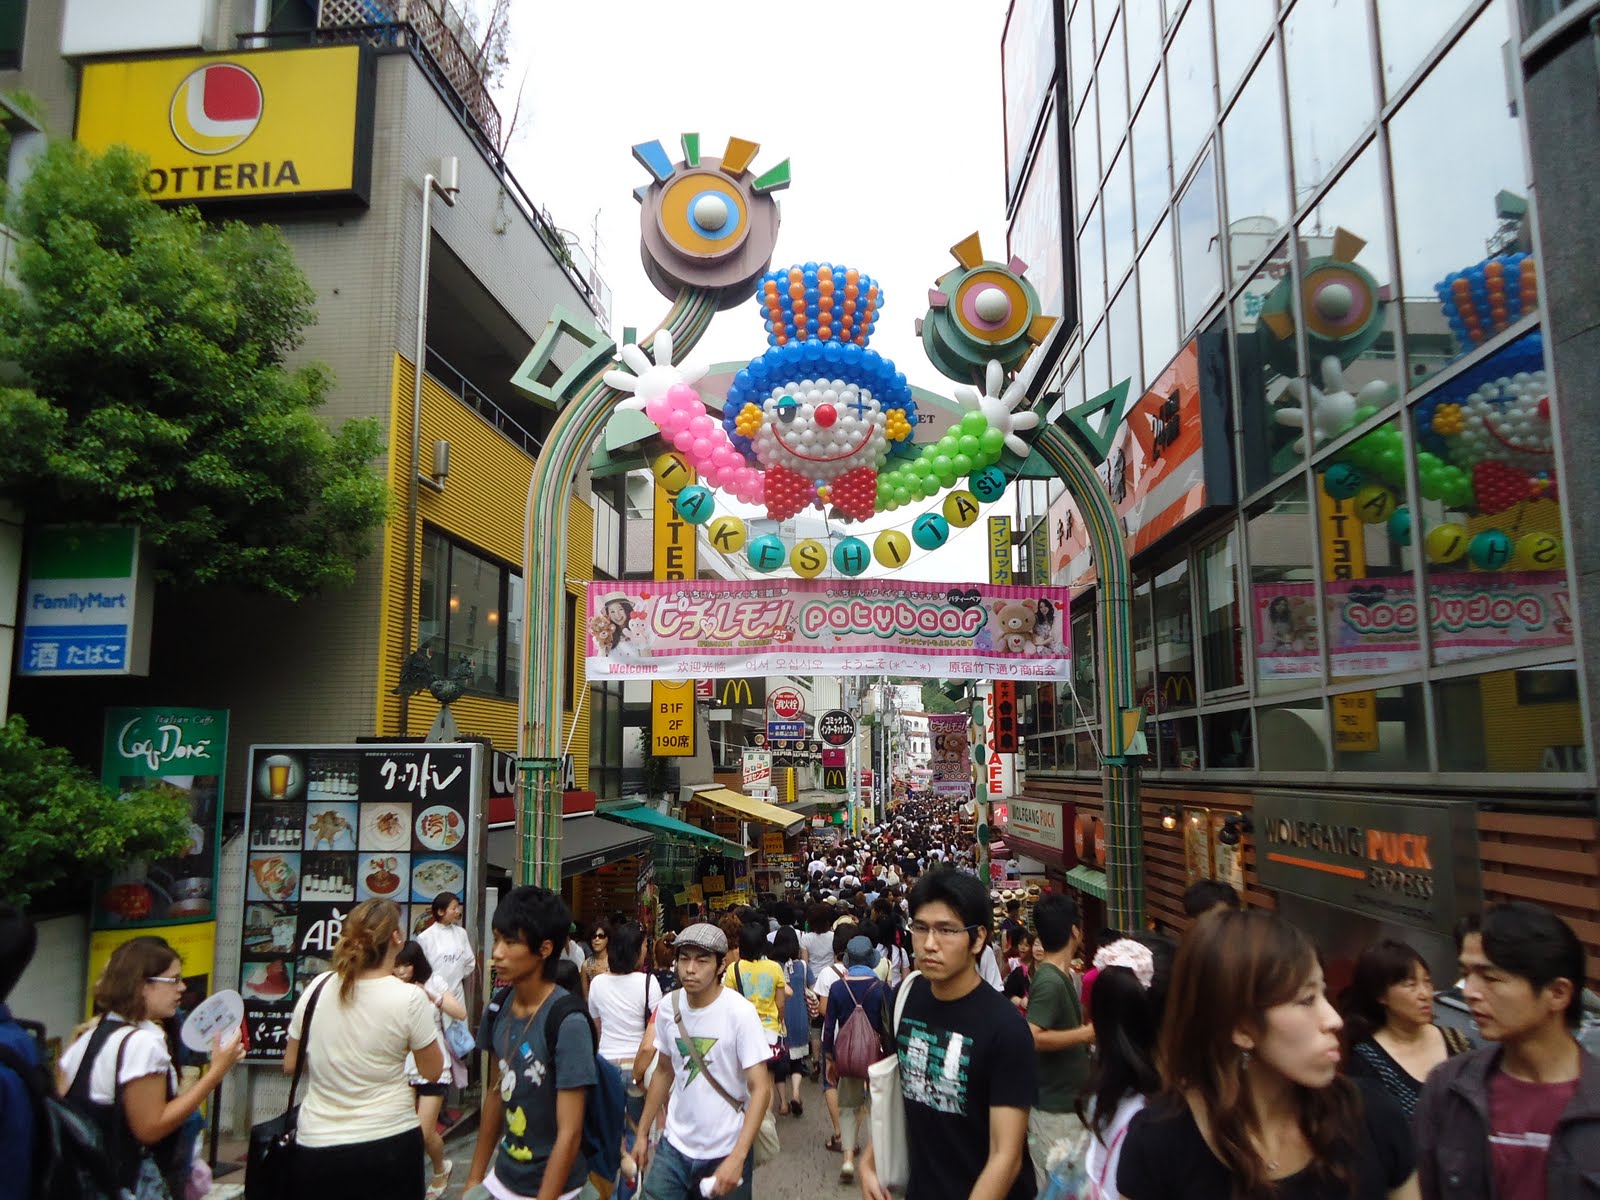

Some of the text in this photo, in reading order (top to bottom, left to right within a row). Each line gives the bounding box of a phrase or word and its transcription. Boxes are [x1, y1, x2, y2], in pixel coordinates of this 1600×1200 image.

[148, 160, 300, 195] OTTERIA
[993, 517, 1009, 584] コインロッカ
[33, 592, 127, 613] FamilyMart
[801, 598, 988, 638] patybear
[30, 643, 121, 668] 酒 たばこ
[746, 658, 824, 671] 어서 오십시오
[609, 663, 658, 674] Welcome
[677, 660, 726, 673] 欢迎光临
[949, 661, 1057, 676] 原宿竹下通り商店会
[775, 699, 798, 710] 消火栓
[668, 720, 684, 731] 2F
[656, 735, 690, 748] 190席
[1264, 816, 1433, 870] WOLFGANG PUCK
[301, 919, 344, 951] AB
